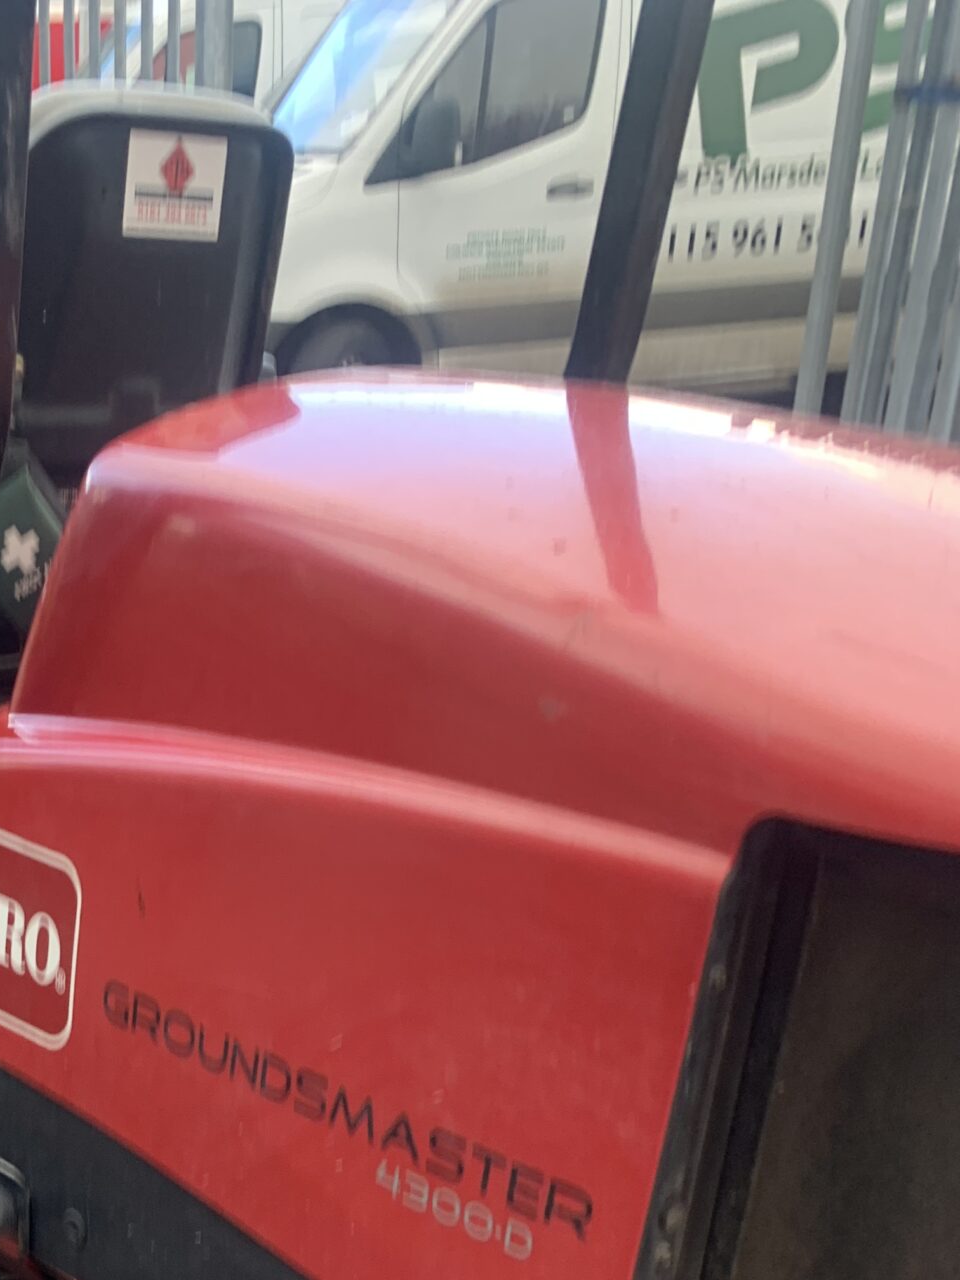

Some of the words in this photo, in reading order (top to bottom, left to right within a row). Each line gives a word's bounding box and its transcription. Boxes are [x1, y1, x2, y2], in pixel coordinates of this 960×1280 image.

[731, 151, 827, 193] Marsde
[667, 219, 720, 263] 115
[732, 214, 784, 256] 961
[103, 978, 594, 1243] GROUNDSMASTER
